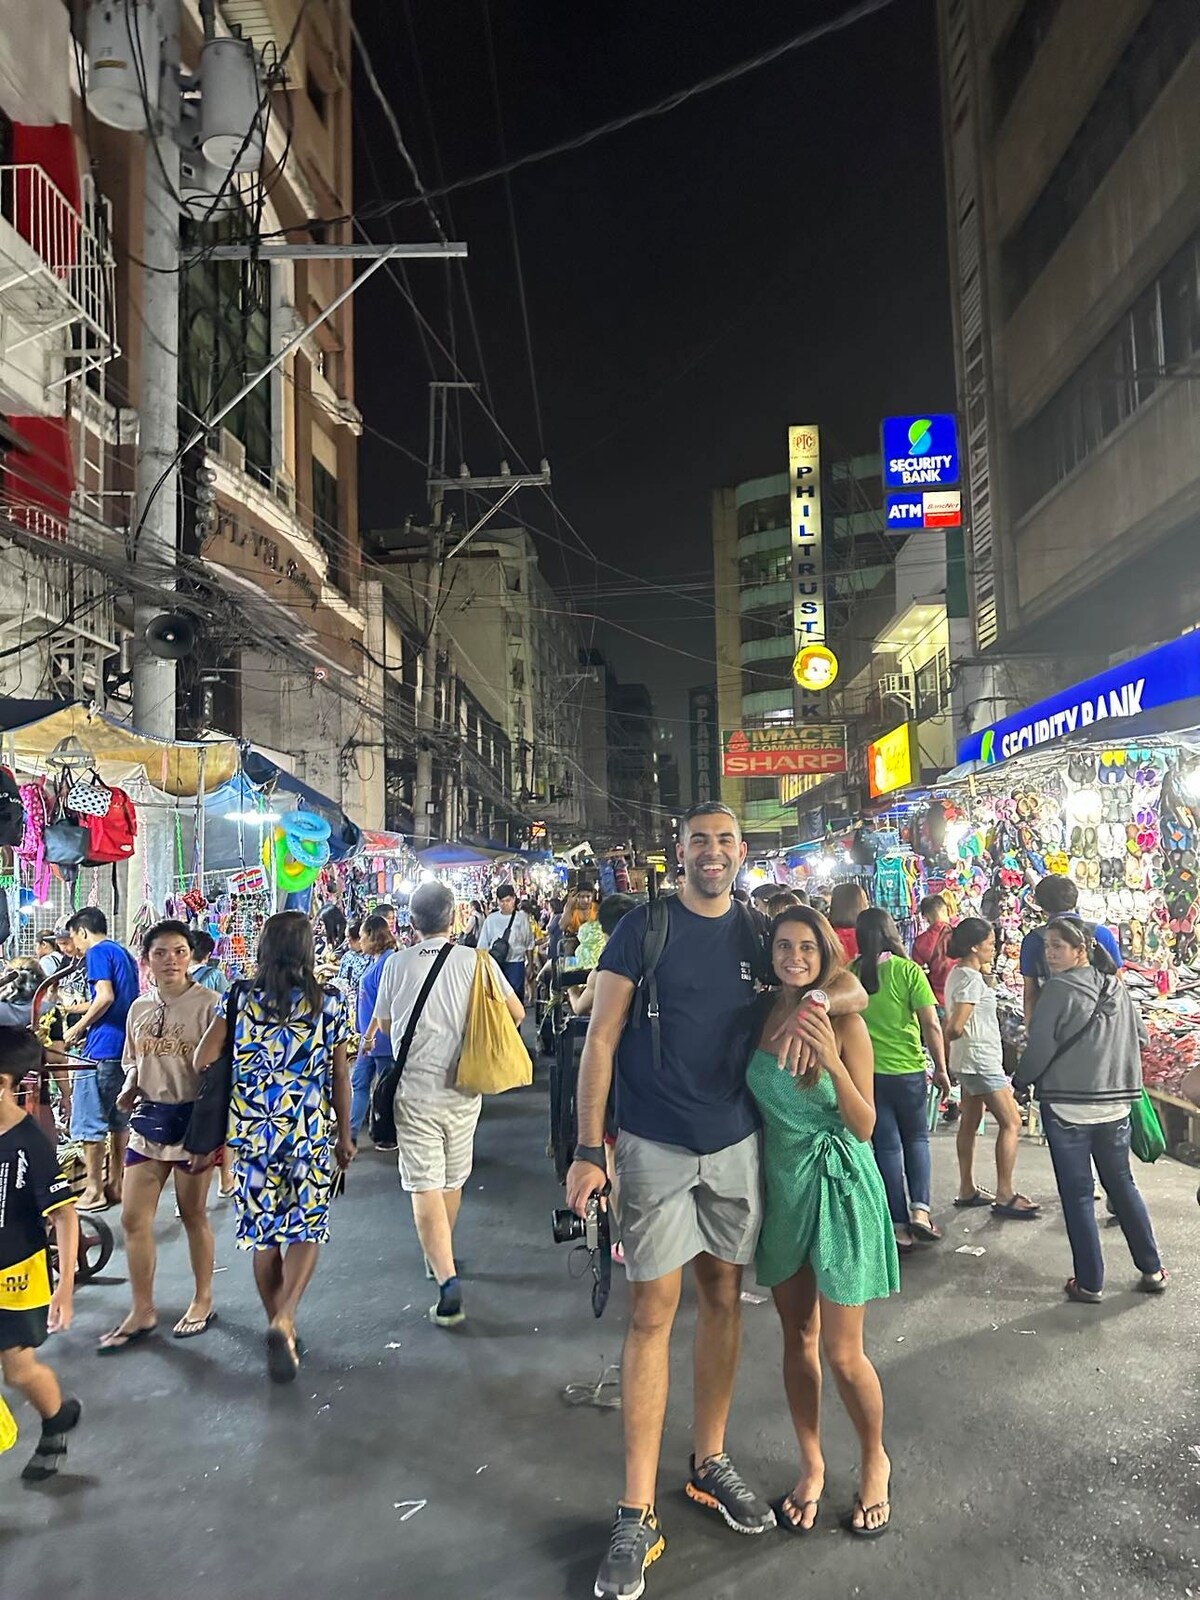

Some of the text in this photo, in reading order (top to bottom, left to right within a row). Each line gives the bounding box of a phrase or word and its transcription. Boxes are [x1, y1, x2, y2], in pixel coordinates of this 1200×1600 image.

[889, 455, 952, 473] SECURITY
[902, 469, 942, 484] BANK
[888, 503, 922, 519] ATM
[796, 466, 818, 634] PHILTRUST
[1081, 678, 1146, 727] BANK
[752, 727, 842, 746] MACE
[752, 742, 842, 752] COMMERCIAL
[726, 753, 843, 772] SHARP
